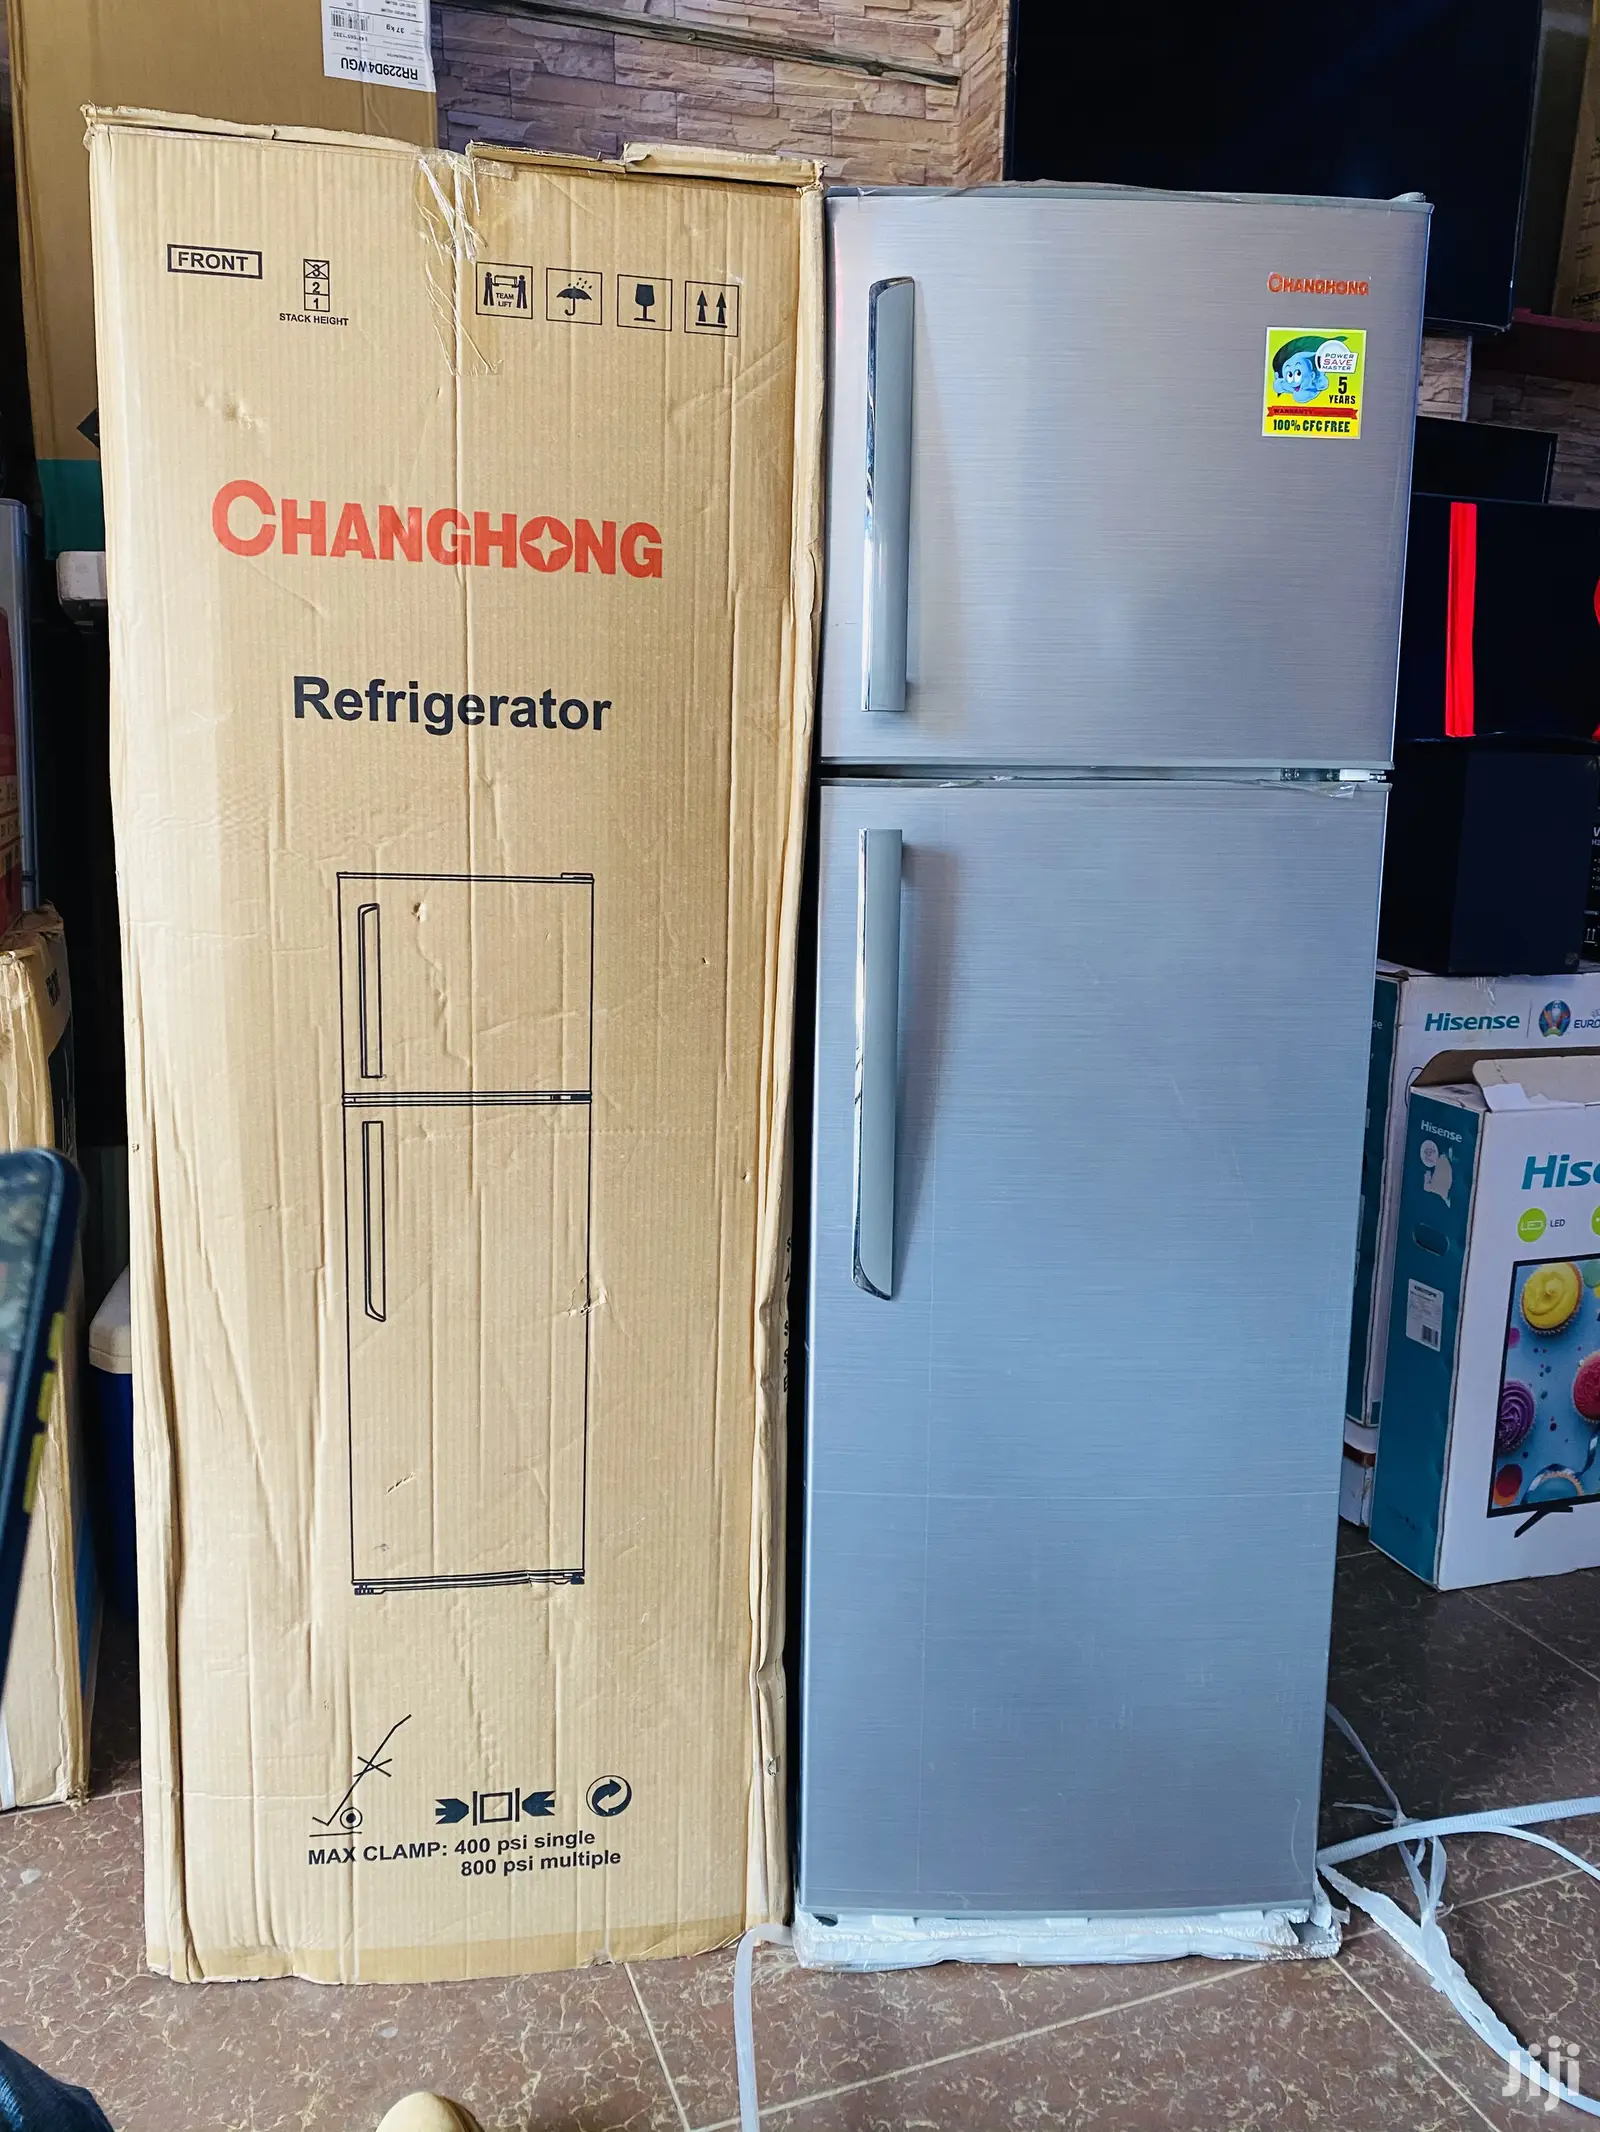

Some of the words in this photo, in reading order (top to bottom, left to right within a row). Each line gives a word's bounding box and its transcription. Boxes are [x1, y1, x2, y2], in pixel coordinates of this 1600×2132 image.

[340, 57, 418, 80] RR229D4WGU
[178, 251, 249, 272] FRONT
[312, 281, 321, 293] 2
[1267, 272, 1369, 296] CHANGHONG
[313, 298, 319, 309] 1
[495, 292, 515, 301] TEAM
[498, 300, 512, 308] LIFT
[279, 313, 311, 324] STACK
[313, 315, 349, 326] HEIGHT
[1323, 358, 1353, 366] SAVE
[1338, 376, 1348, 395] 5
[1328, 394, 1356, 405] YEARS
[1273, 419, 1301, 432] 100%
[1302, 420, 1323, 432] CFC
[1324, 421, 1350, 433] FREE
[211, 479, 663, 579] CHANGHONG
[293, 675, 612, 736] Refrigerator
[1424, 1012, 1520, 1032] Hisense
[1420, 1119, 1463, 1143] Hisense
[1550, 1218, 1566, 1228] LED
[308, 1848, 357, 1866] MAX
[363, 1841, 448, 1862] CLAMP:
[454, 1838, 491, 1855] 400
[497, 1834, 528, 1855] psi
[534, 1830, 595, 1854] single
[460, 1859, 496, 1877] 800
[503, 1856, 534, 1877] psi
[540, 1850, 621, 1875] multiple
